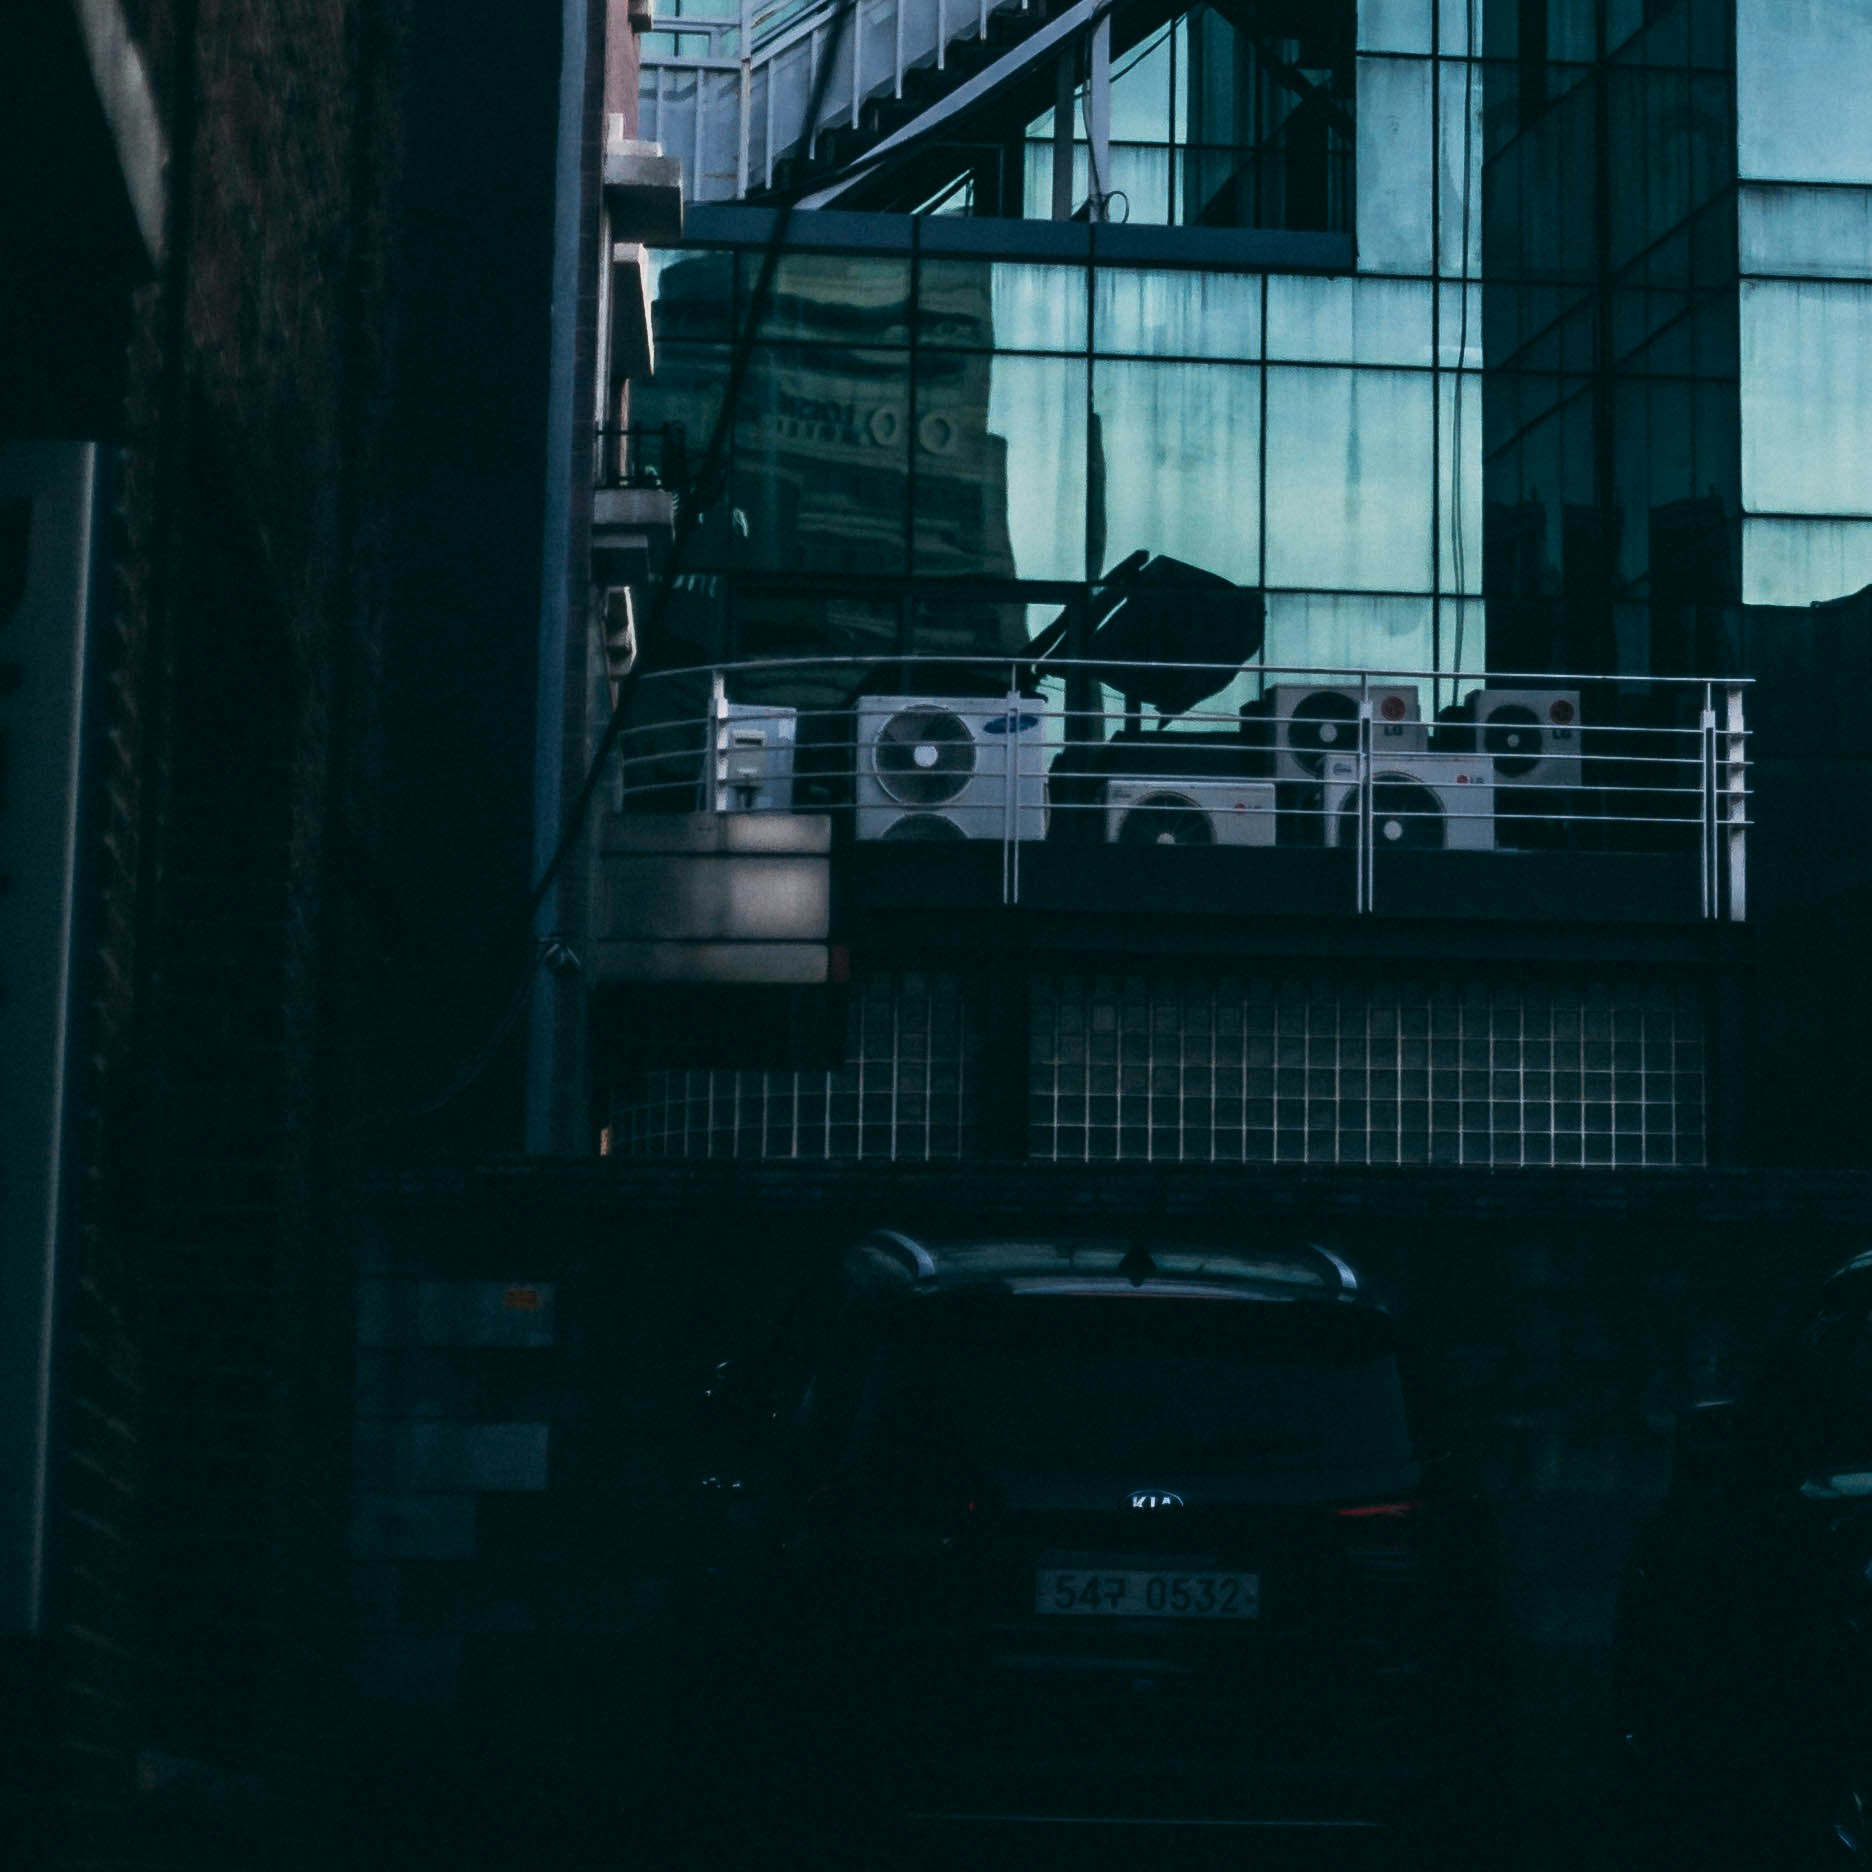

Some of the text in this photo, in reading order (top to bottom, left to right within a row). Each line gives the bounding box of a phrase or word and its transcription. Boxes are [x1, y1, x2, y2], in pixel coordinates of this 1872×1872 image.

[1384, 724, 1403, 736] LG
[1132, 1496, 1171, 1508] KIA
[1145, 1576, 1240, 1613] 0532
